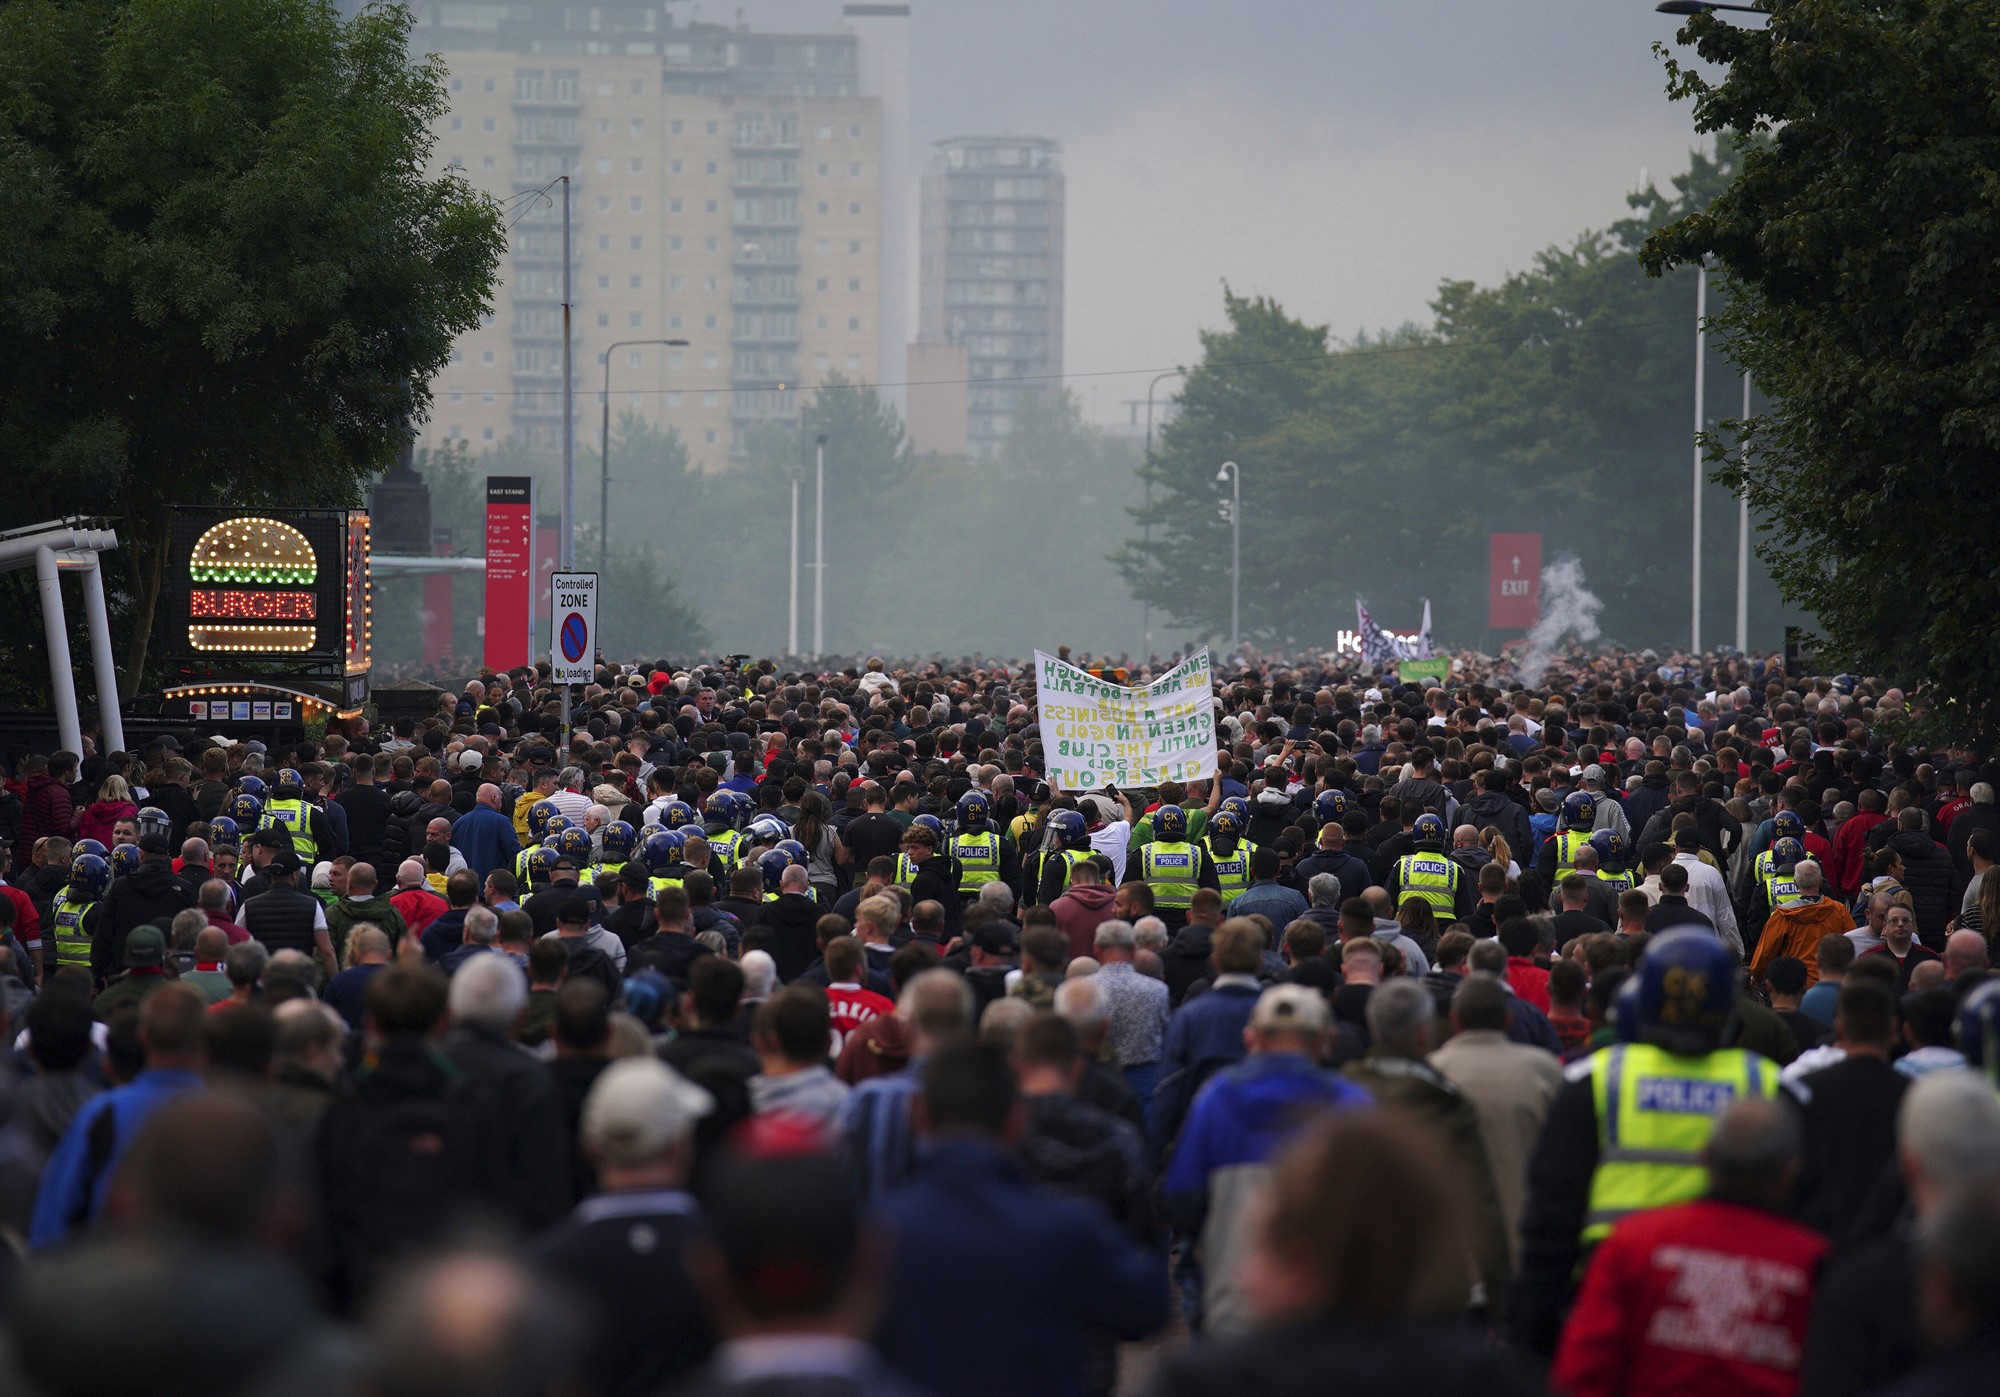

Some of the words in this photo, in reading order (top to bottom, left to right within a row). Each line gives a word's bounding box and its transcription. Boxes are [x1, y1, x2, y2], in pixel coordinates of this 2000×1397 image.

[556, 579, 593, 590] Controlled
[1502, 580, 1529, 595] EXIT
[191, 590, 315, 618] BURGER
[560, 594, 588, 607] ZONE
[1334, 795, 1346, 803] CK
[1580, 804, 1592, 812] CK
[536, 809, 550, 817] CK
[671, 809, 684, 817] CK
[608, 826, 621, 834] CK
[1422, 823, 1436, 831] CK
[73, 845, 86, 853] CK
[669, 847, 680, 855] CK
[959, 847, 988, 857] POLICE
[113, 851, 127, 860] CK
[531, 855, 545, 864] CK
[669, 856, 675, 864] P
[72, 864, 85, 872] CK
[1215, 863, 1241, 874] OLICE
[1414, 862, 1445, 873] POLICE
[1774, 884, 1800, 895] POLIC
